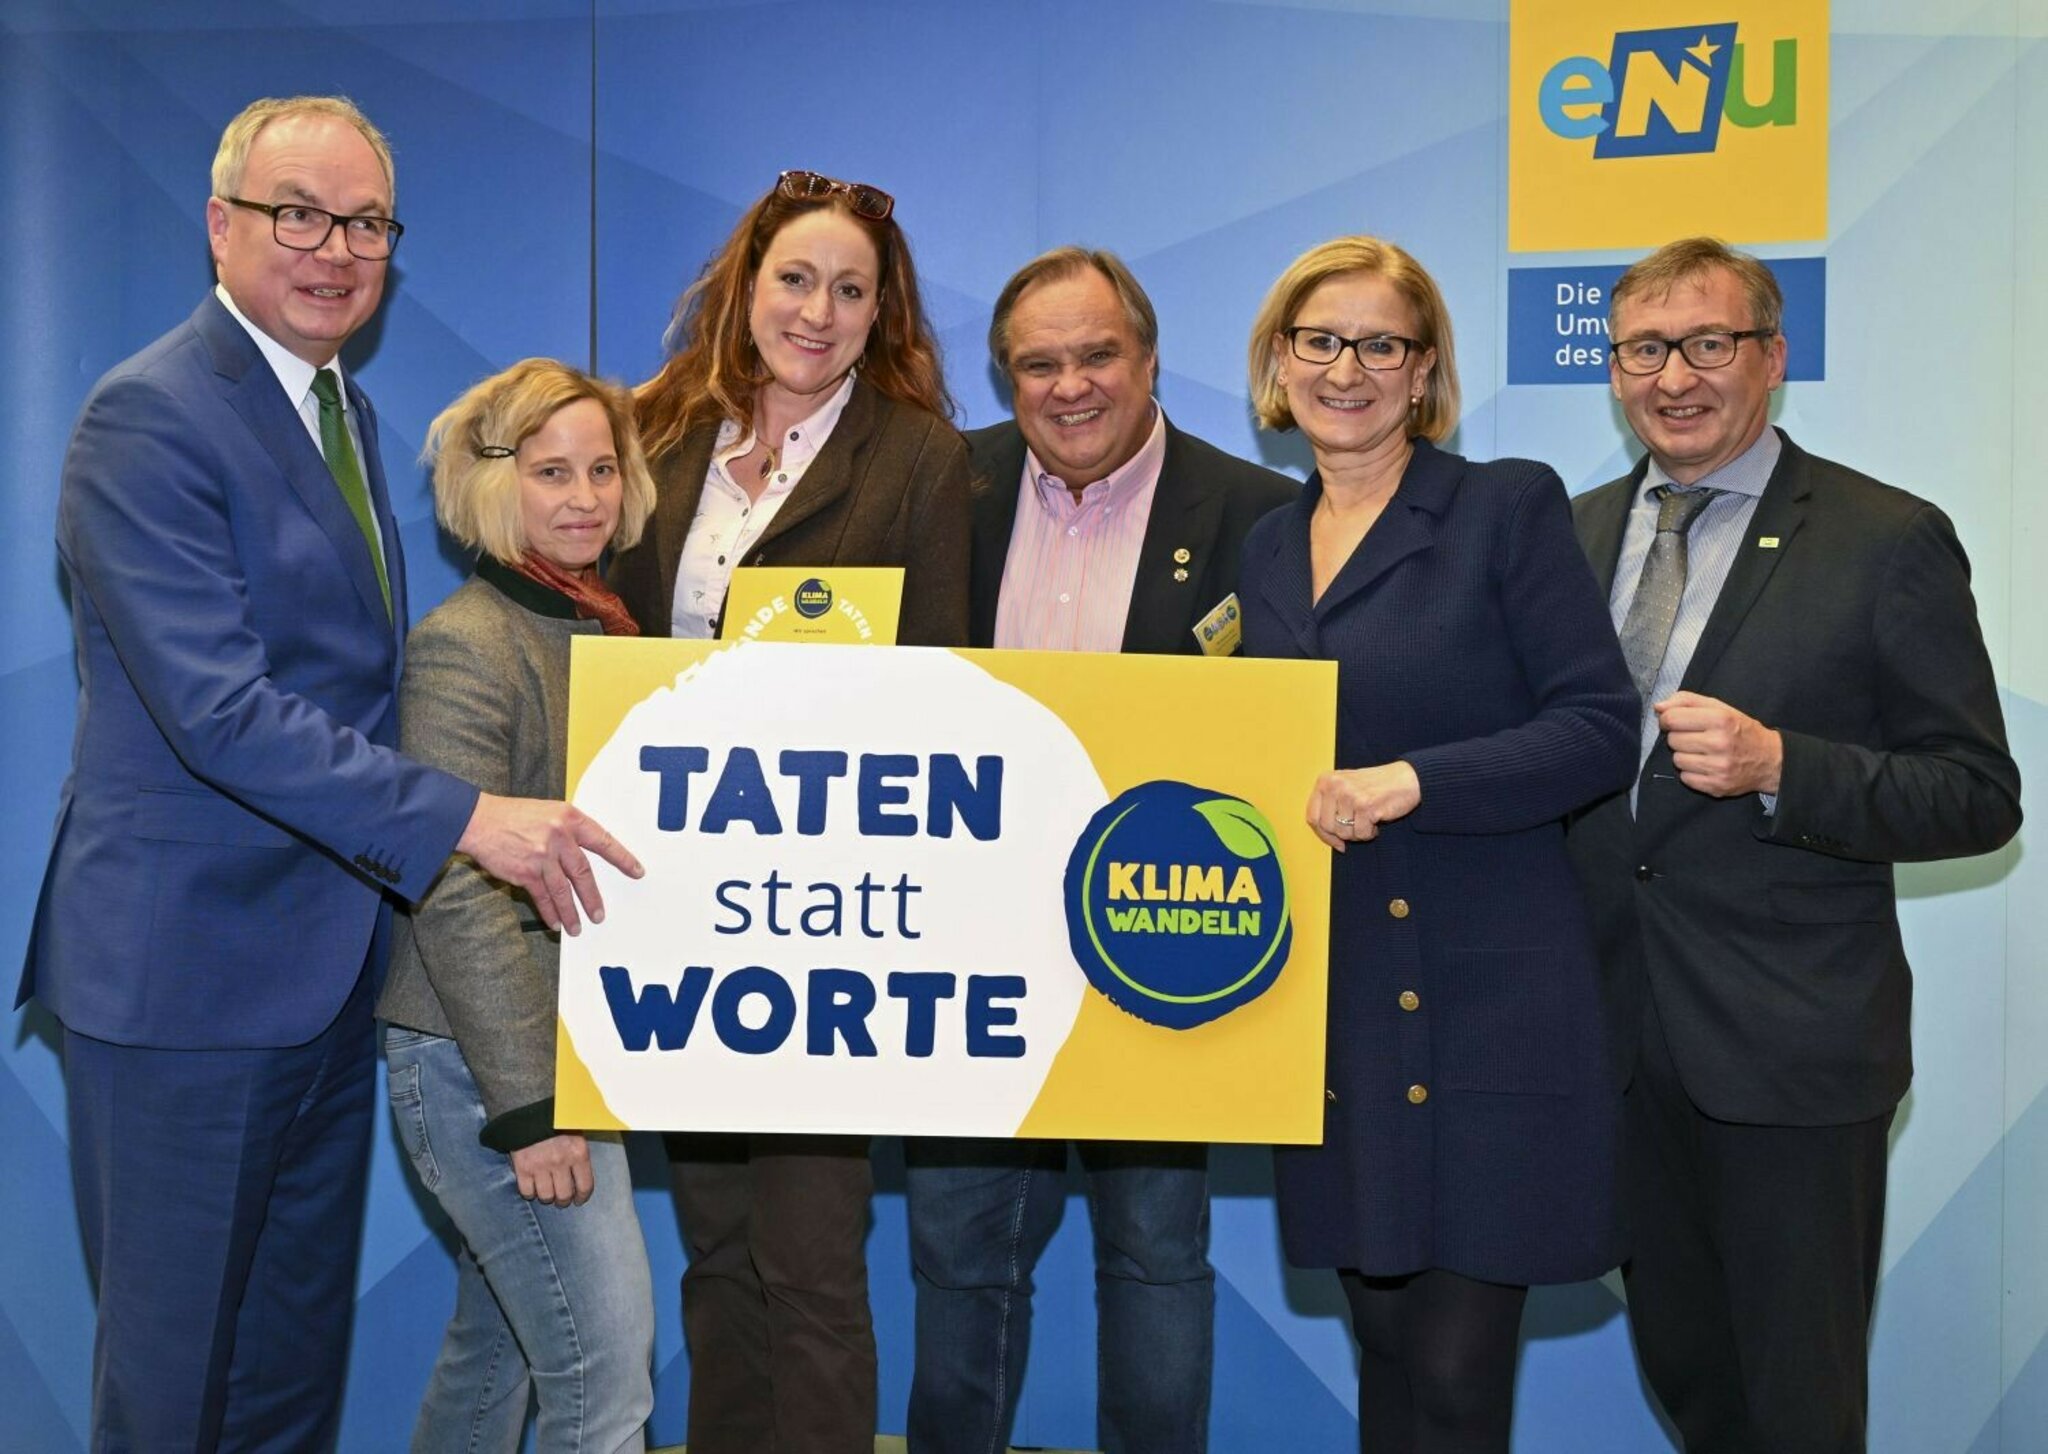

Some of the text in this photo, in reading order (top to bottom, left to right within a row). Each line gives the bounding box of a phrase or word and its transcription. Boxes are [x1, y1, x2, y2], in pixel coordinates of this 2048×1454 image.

[1557, 282, 1601, 305] Die
[1555, 343, 1603, 366] des
[837, 598, 873, 640] TATEN
[640, 746, 1003, 841] TATEN
[1108, 862, 1262, 904] KLIMA
[715, 870, 921, 939] statt
[1106, 908, 1260, 936] WANDELN
[599, 966, 1027, 1058] WORTE
